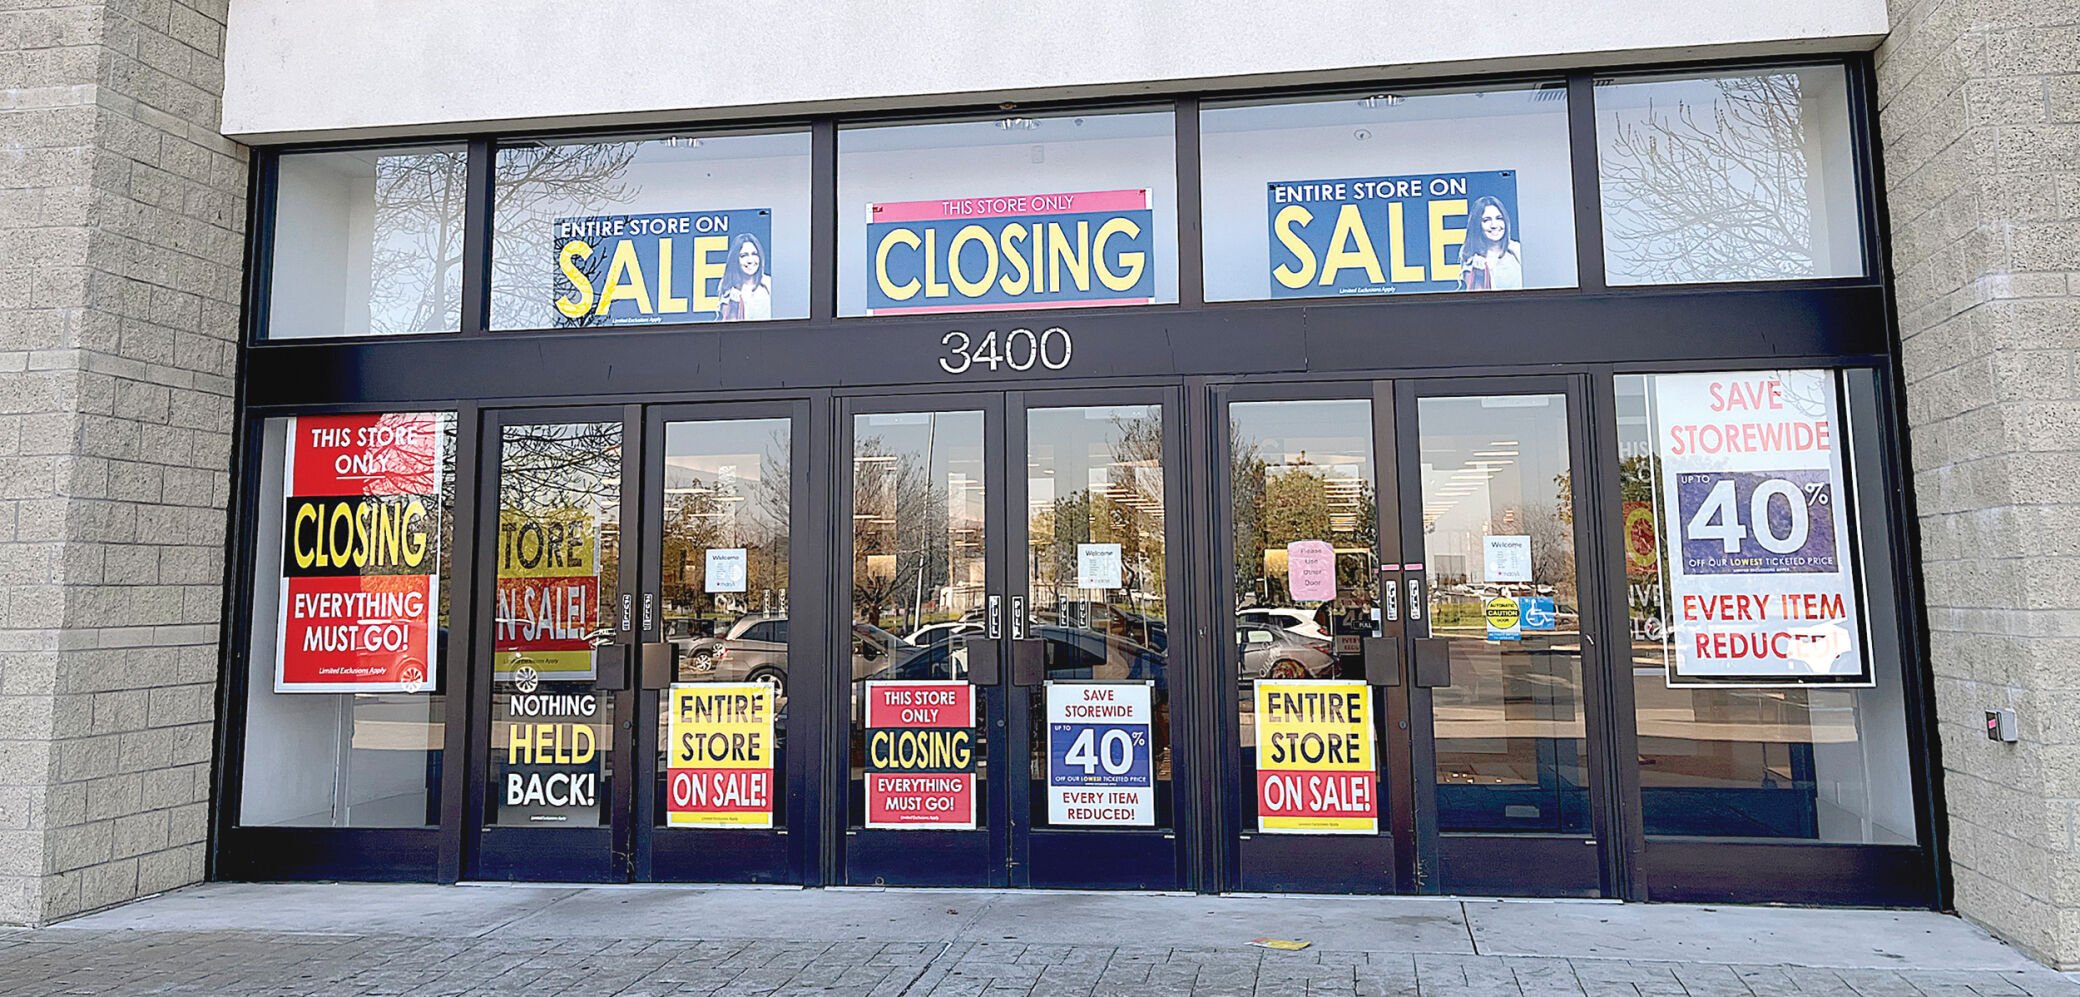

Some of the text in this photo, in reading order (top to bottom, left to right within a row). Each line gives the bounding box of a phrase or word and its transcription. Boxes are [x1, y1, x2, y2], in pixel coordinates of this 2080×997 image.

[1276, 178, 1467, 203] ENTIRE STORE ON
[942, 195, 1074, 217] THIS STORE ONLY
[561, 216, 728, 238] ENTIRE STORE ON
[1272, 199, 1468, 289] SALE
[875, 217, 1146, 301] CLOSING
[554, 236, 729, 318] SALE
[939, 327, 1072, 374] 3400
[1709, 380, 1783, 412] SAVE
[312, 425, 418, 448] THIS STORE
[1670, 421, 1831, 455] STOREWIDE
[335, 453, 390, 475] ONLY
[1696, 475, 1711, 484] TO
[1687, 478, 1828, 554] 40%
[294, 502, 427, 569] CLOSING
[502, 520, 584, 569] TORE
[1491, 541, 1522, 549] Welcome
[1689, 557, 1833, 568] OFF OUR LOWEST TICKETED PRICE
[295, 591, 424, 619] EVERYTHING
[498, 585, 587, 641] N SALE!
[991, 597, 999, 635] PULL
[1683, 594, 1769, 621] EVERY
[1782, 593, 1846, 620] ITEM
[303, 624, 409, 652] MUST GO!
[319, 666, 387, 676] Limited Exclusions Apply
[510, 694, 596, 716] NOTHING
[681, 694, 764, 724] ENTIRE
[884, 691, 956, 705] THIS STORE
[1083, 689, 1114, 701] SAVE
[1268, 692, 1361, 724] ENTIRE
[901, 709, 939, 723] ONLY
[1065, 705, 1133, 718] STOREWIDE
[509, 724, 596, 764] HELD
[681, 732, 760, 762] STORE
[871, 730, 971, 769] CLOSING
[1065, 728, 1146, 775] 40%
[1271, 732, 1361, 764] STORE
[507, 773, 595, 807] BACK!
[673, 773, 767, 807] ON SALE!
[878, 778, 963, 793] EVERYTHING
[1063, 792, 1139, 805] EVERY ITEM
[1264, 775, 1371, 812] ON SALE!
[885, 796, 955, 811] MUST GO!
[1068, 808, 1135, 821] REDUCED!
